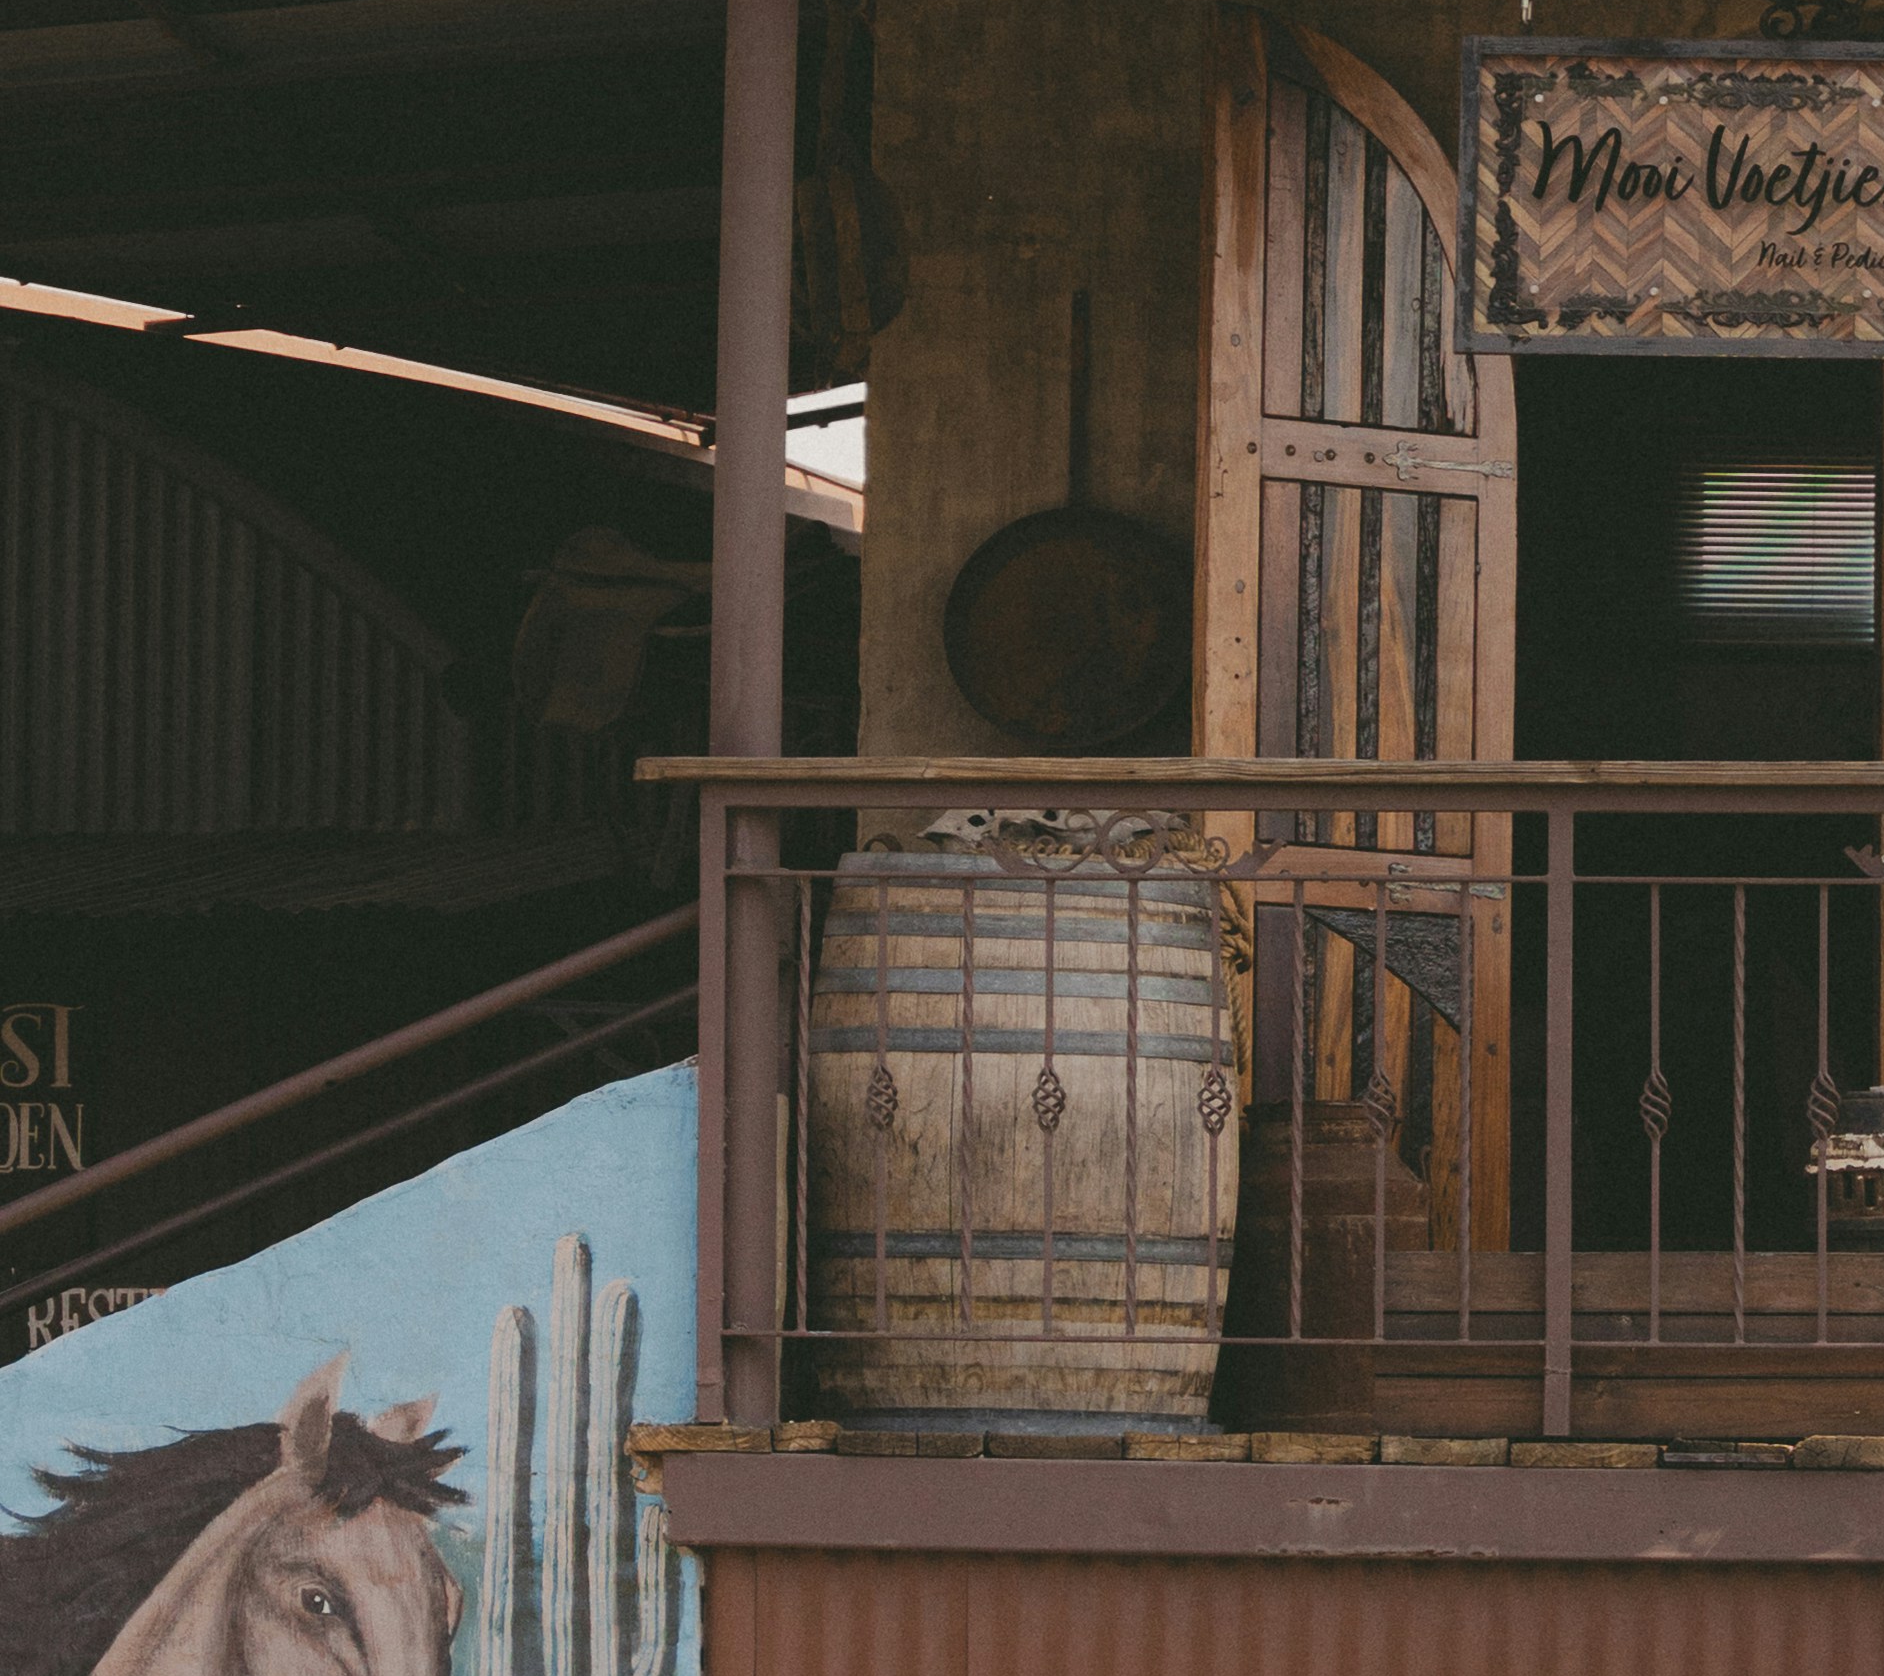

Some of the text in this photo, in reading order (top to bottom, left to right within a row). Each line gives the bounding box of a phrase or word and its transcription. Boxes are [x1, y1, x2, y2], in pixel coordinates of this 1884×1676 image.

[1532, 120, 1694, 212] Mooi
[1757, 241, 1807, 268] Nail
[1813, 242, 1825, 271] &
